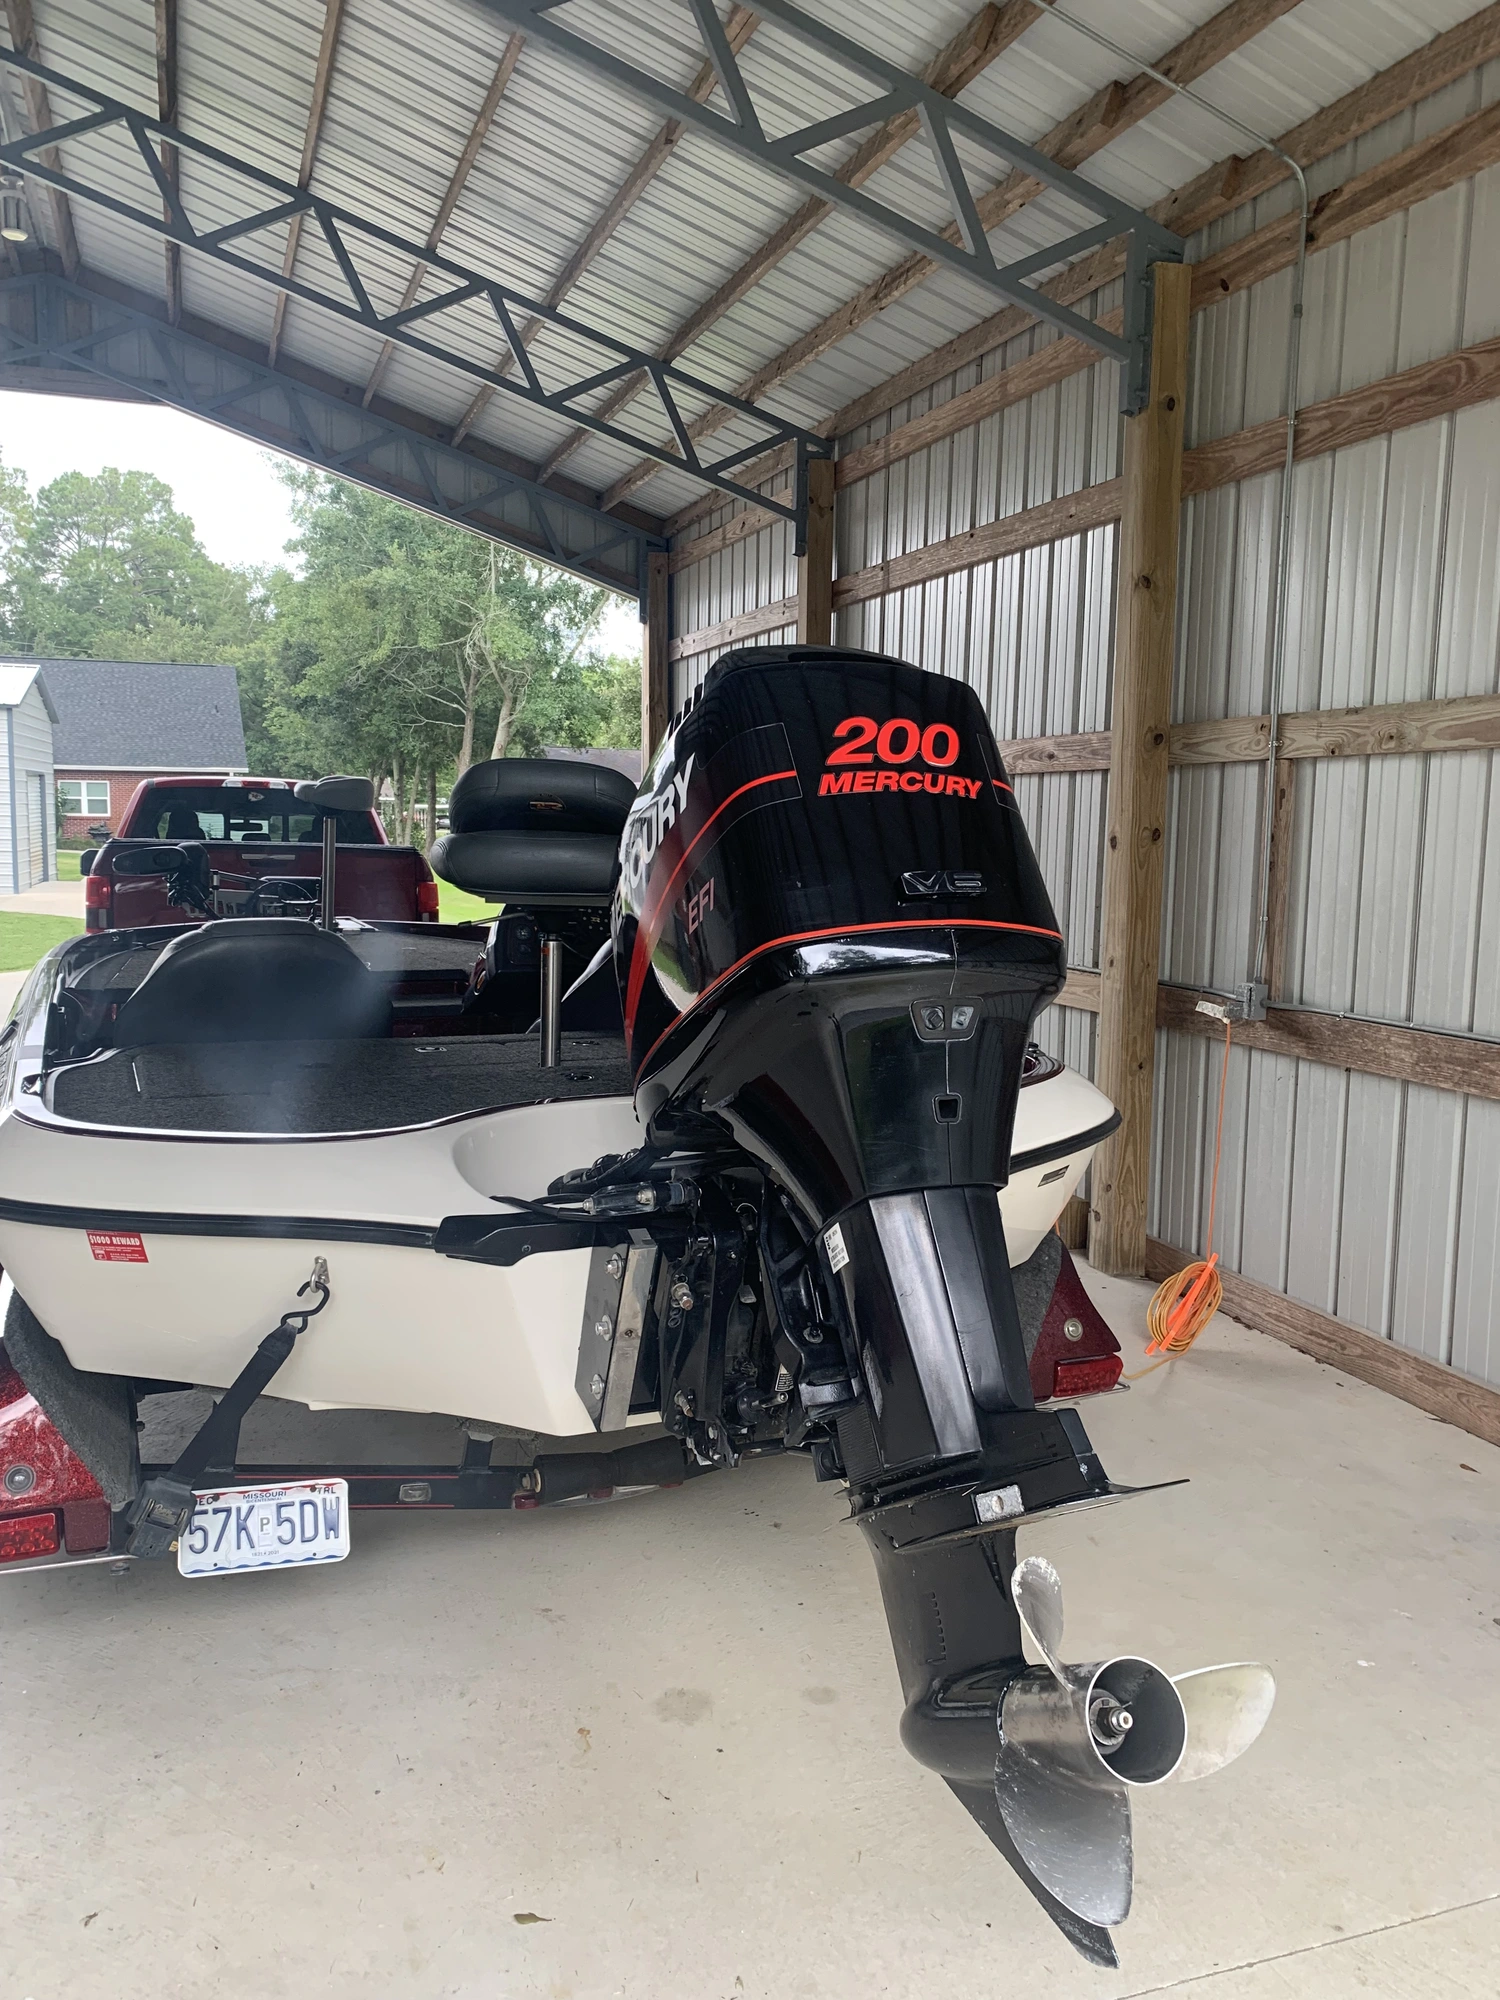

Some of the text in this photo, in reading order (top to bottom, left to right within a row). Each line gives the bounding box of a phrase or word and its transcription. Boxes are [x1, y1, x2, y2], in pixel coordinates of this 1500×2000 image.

[825, 716, 960, 767] 200
[817, 770, 983, 799] MERCURY
[610, 752, 696, 945] ERCURY
[900, 870, 988, 896] V6
[688, 876, 715, 936] EFI
[89, 1235, 140, 1245] $1000 REWARD
[195, 1496, 214, 1506] EC
[242, 1490, 288, 1500] MISSOURI
[188, 1505, 255, 1554] 57K
[276, 1496, 340, 1545] 5DW
